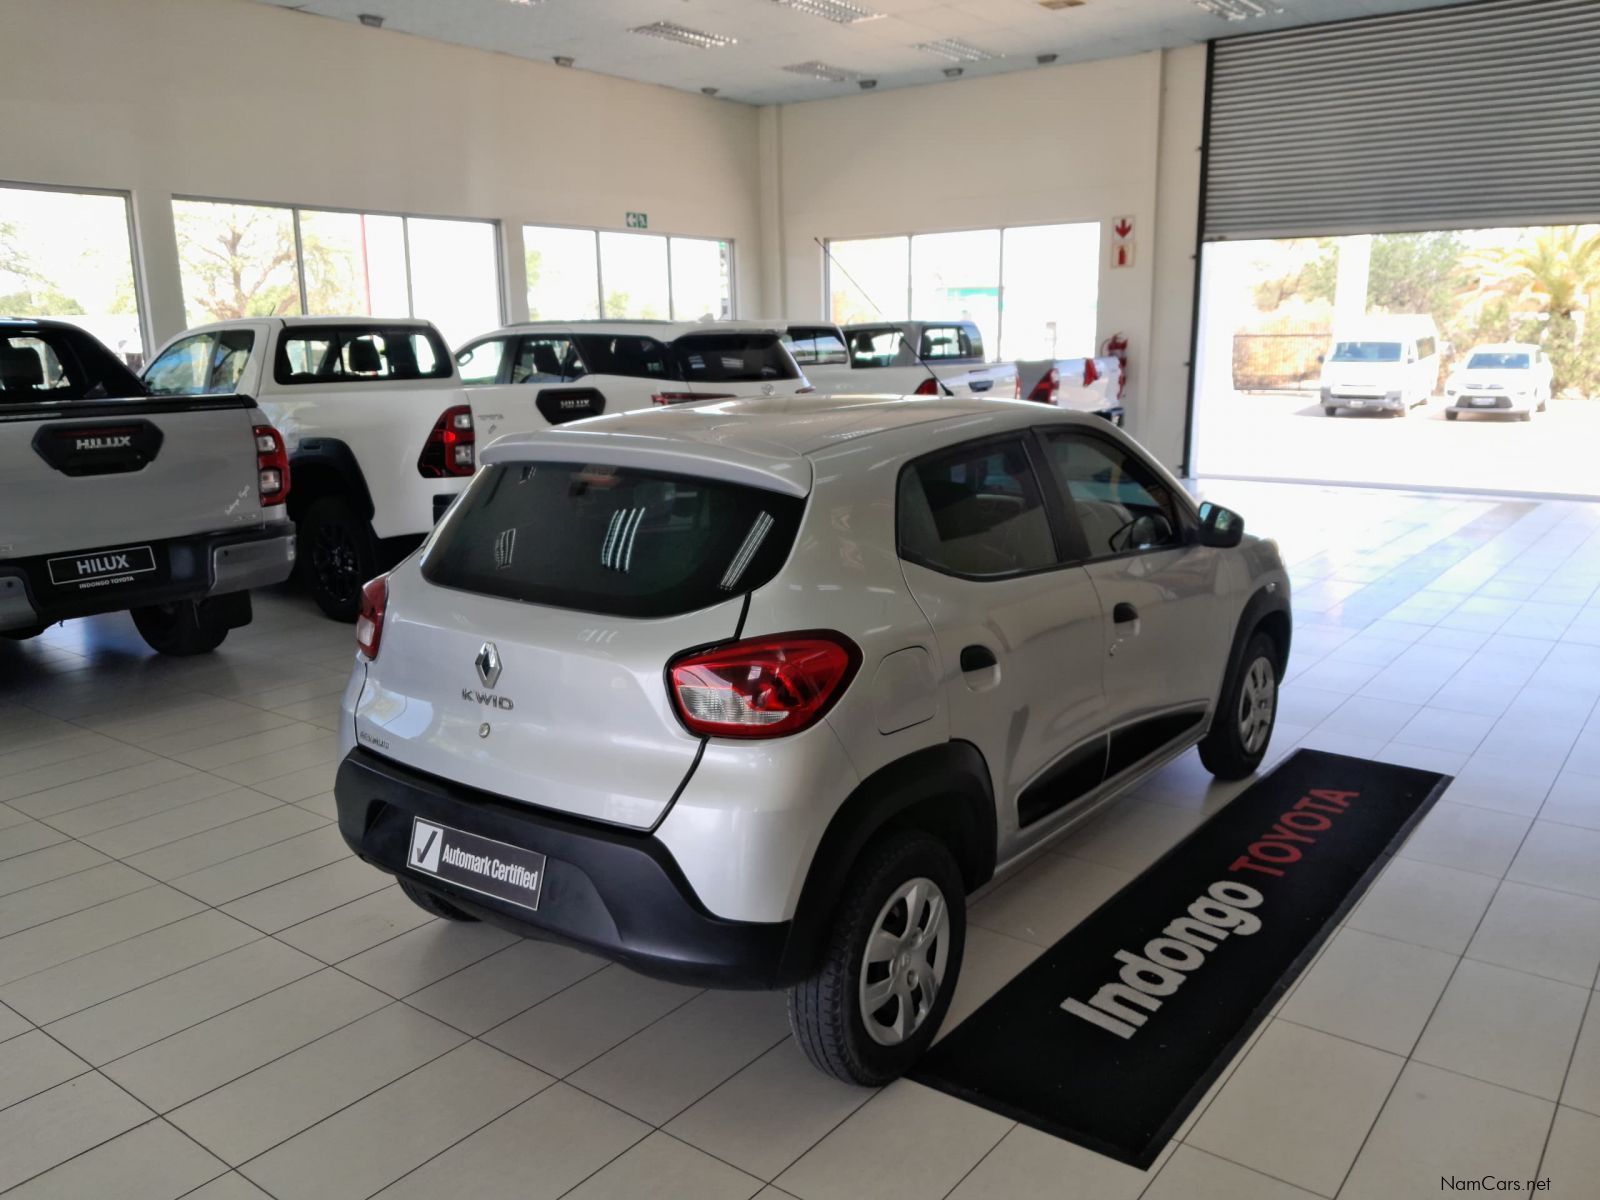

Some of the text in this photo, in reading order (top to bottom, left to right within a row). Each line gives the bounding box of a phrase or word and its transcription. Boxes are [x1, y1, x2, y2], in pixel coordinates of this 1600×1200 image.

[76, 435, 131, 450] HILUX
[76, 554, 130, 575] HILUX
[79, 576, 135, 589] INDONGO TOYOTA
[462, 688, 514, 711] KWID
[442, 843, 539, 891] Automark Certified
[1060, 788, 1360, 1040] Indongo TOYOTA
